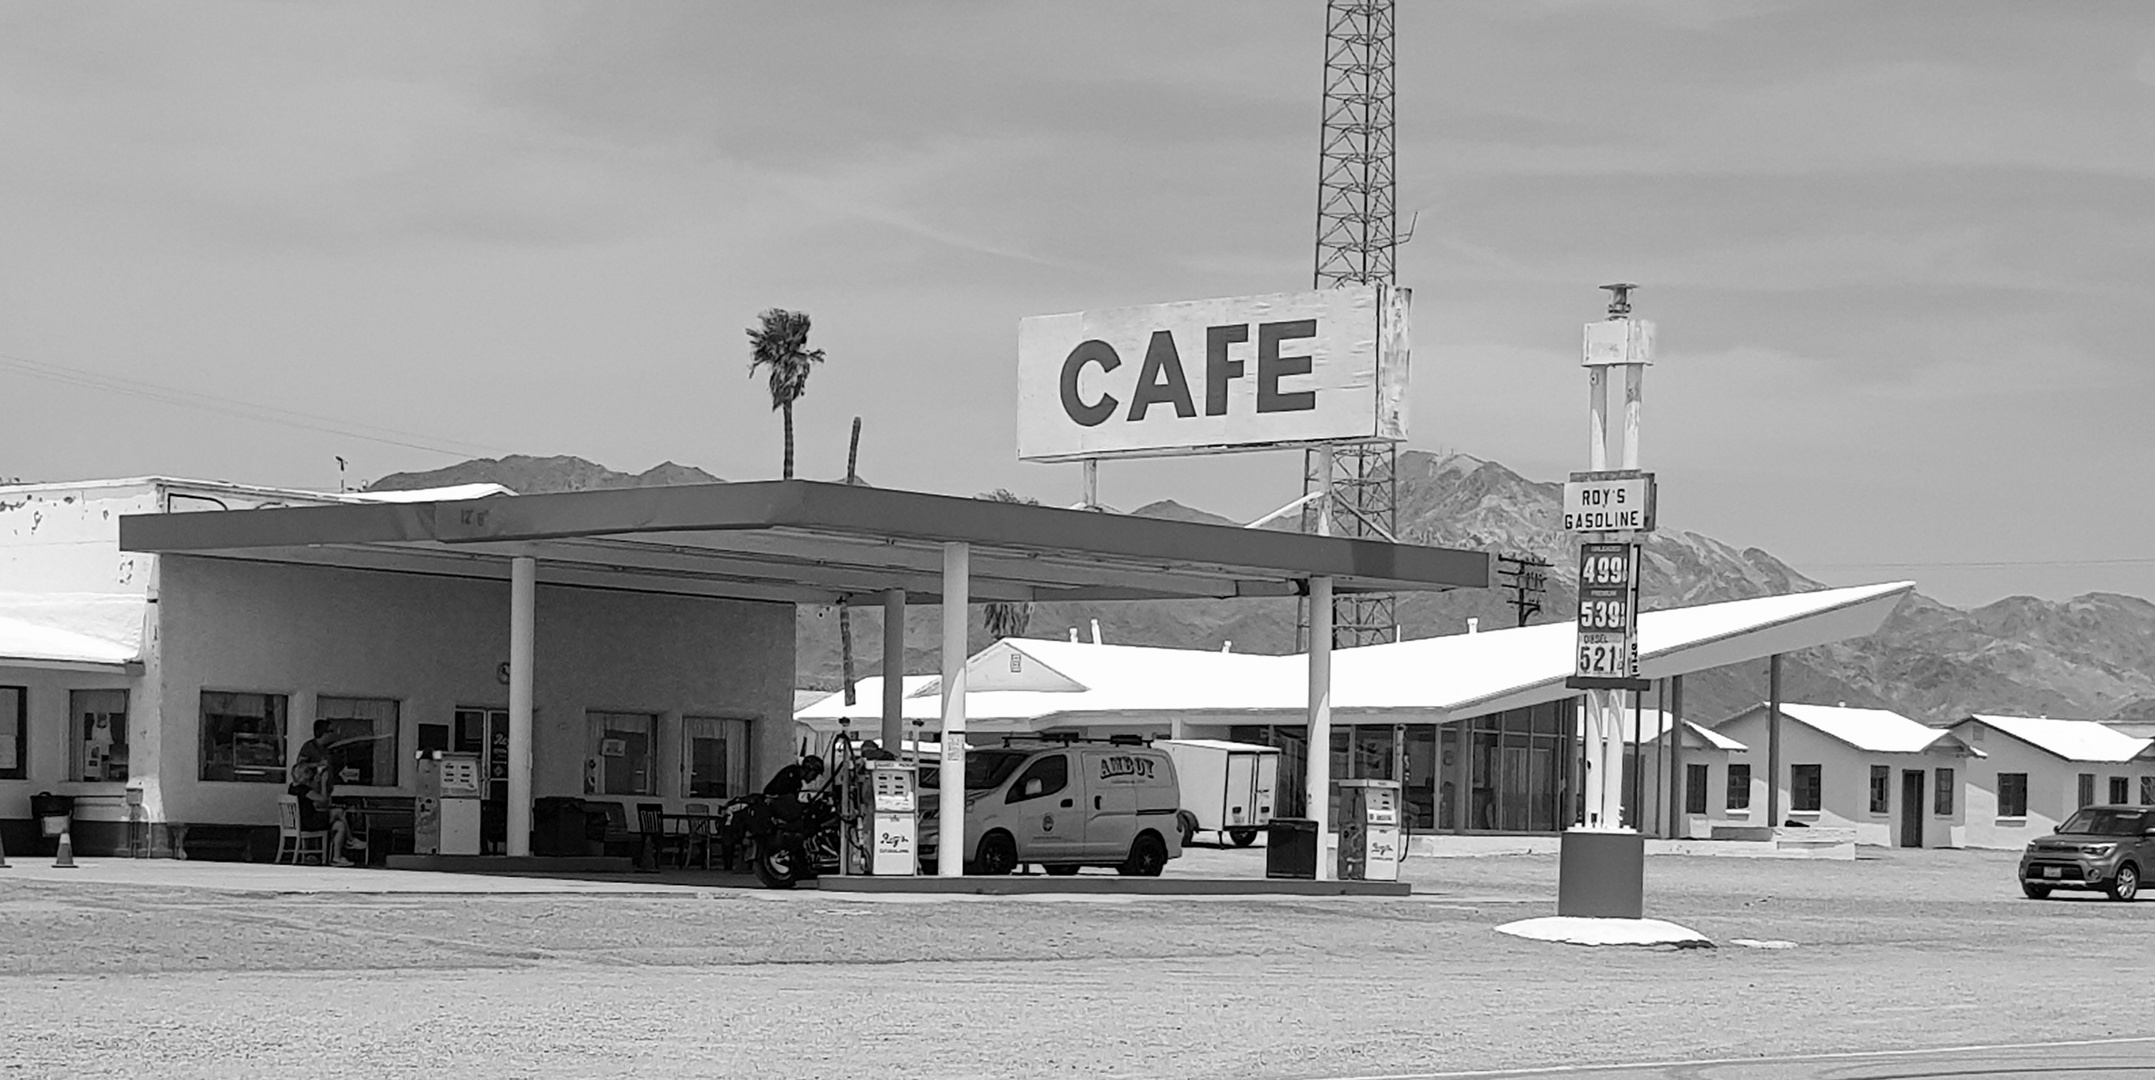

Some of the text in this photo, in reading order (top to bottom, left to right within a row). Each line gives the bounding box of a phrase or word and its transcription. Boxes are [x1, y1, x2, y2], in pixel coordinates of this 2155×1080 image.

[1060, 319, 1317, 427] CAFE
[1582, 488, 1626, 508] ROY'S
[1565, 510, 1639, 530] GASOLINE
